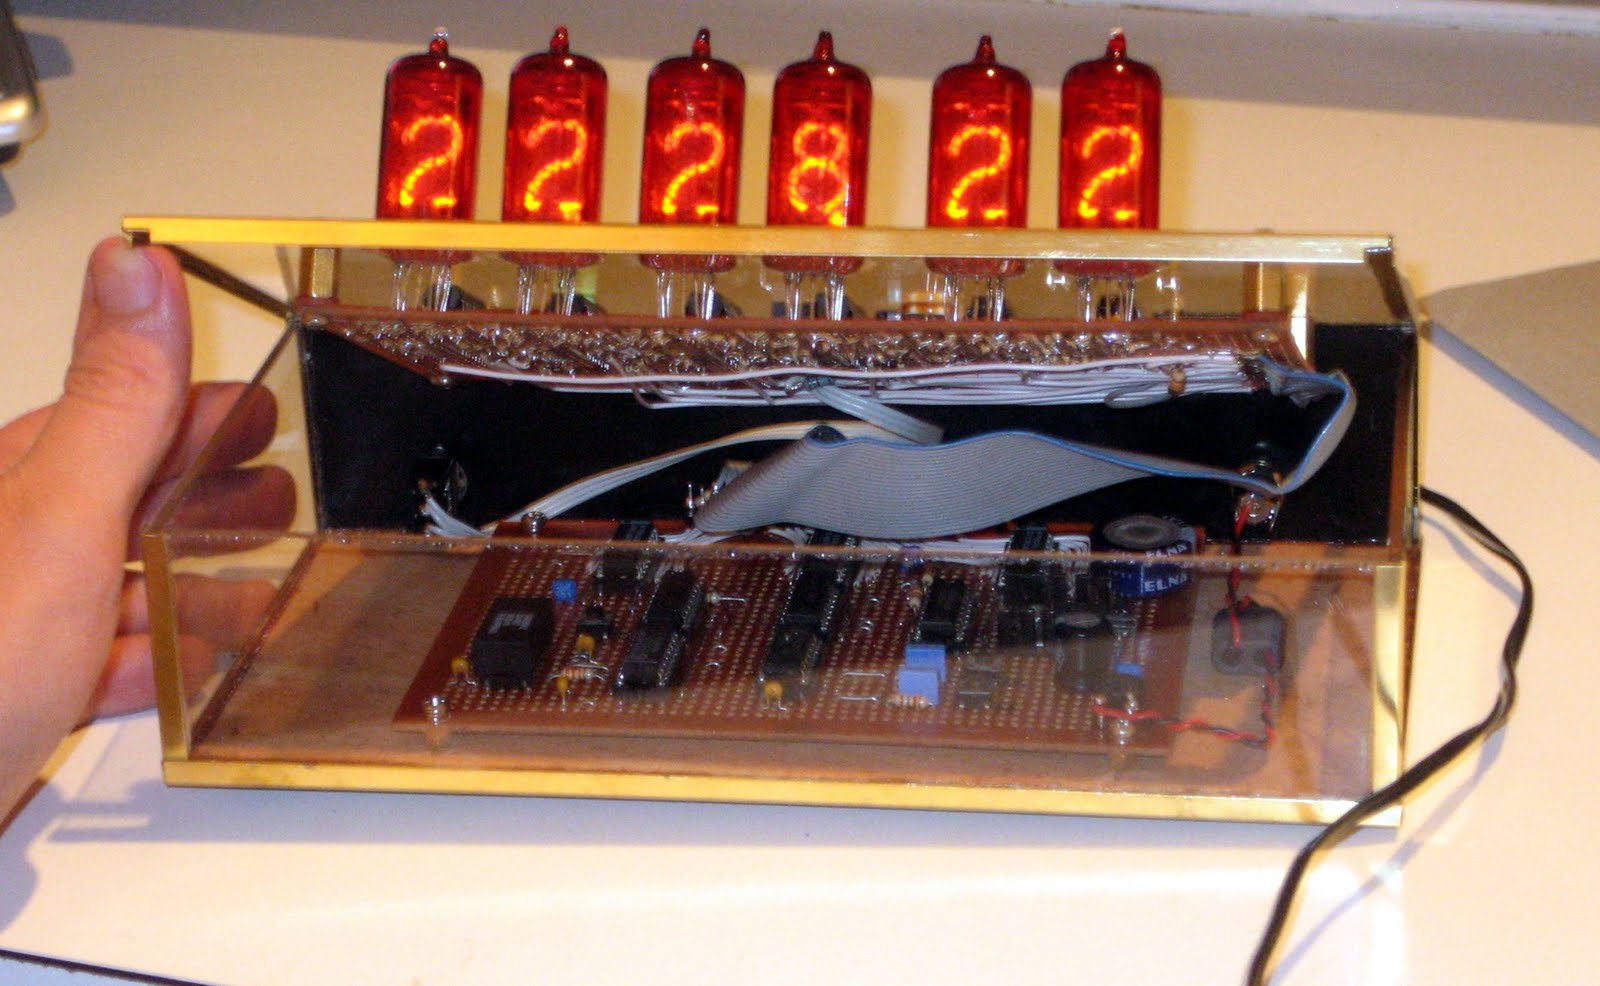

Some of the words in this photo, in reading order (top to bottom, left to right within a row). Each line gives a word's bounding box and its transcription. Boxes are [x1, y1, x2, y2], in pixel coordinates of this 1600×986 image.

[401, 115, 463, 207] 2
[524, 118, 586, 212] 2
[662, 122, 724, 214] 2
[945, 125, 1011, 219] 2
[1078, 125, 1143, 219] 2
